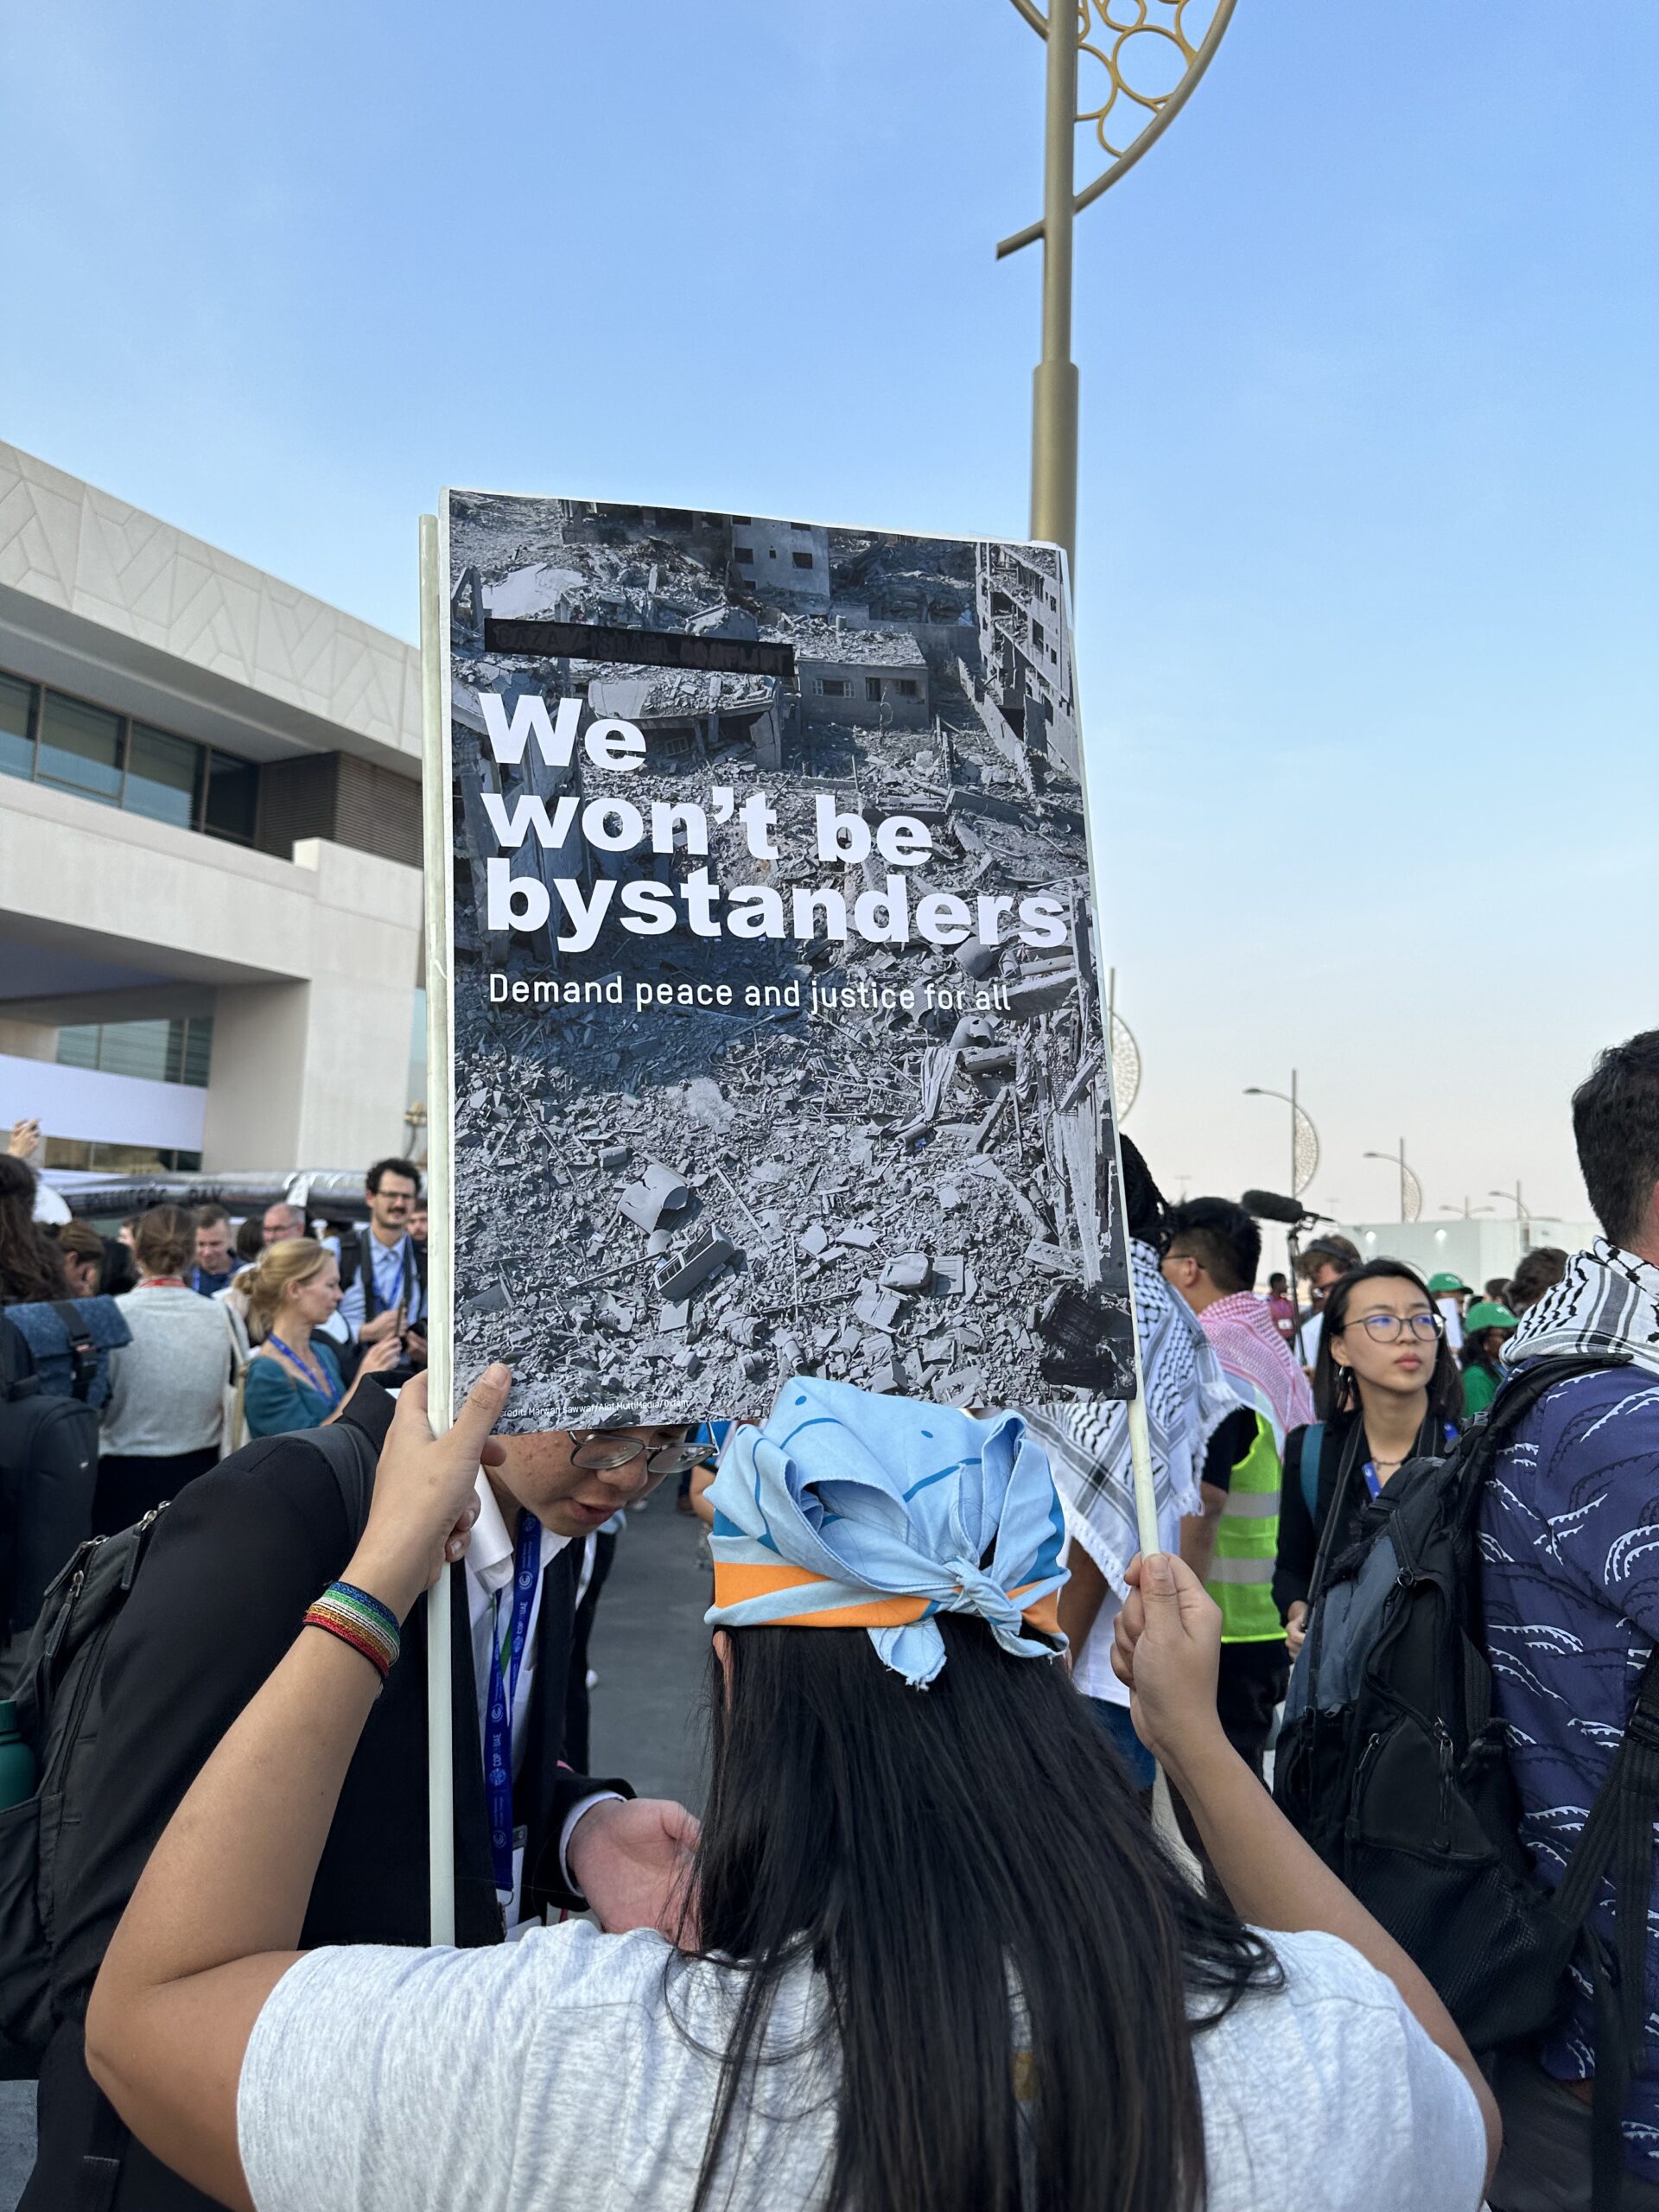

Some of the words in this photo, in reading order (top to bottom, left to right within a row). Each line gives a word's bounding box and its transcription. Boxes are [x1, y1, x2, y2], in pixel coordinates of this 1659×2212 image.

[480, 692, 647, 772] We
[816, 794, 934, 866] be
[486, 858, 1068, 952] bystanders
[489, 973, 623, 1005] Demand
[635, 982, 733, 1013] peace
[745, 982, 799, 1008] and
[810, 982, 915, 1014] justice
[925, 982, 968, 1010] for
[976, 982, 1011, 1011] all
[528, 1407, 561, 1416] Marwan
